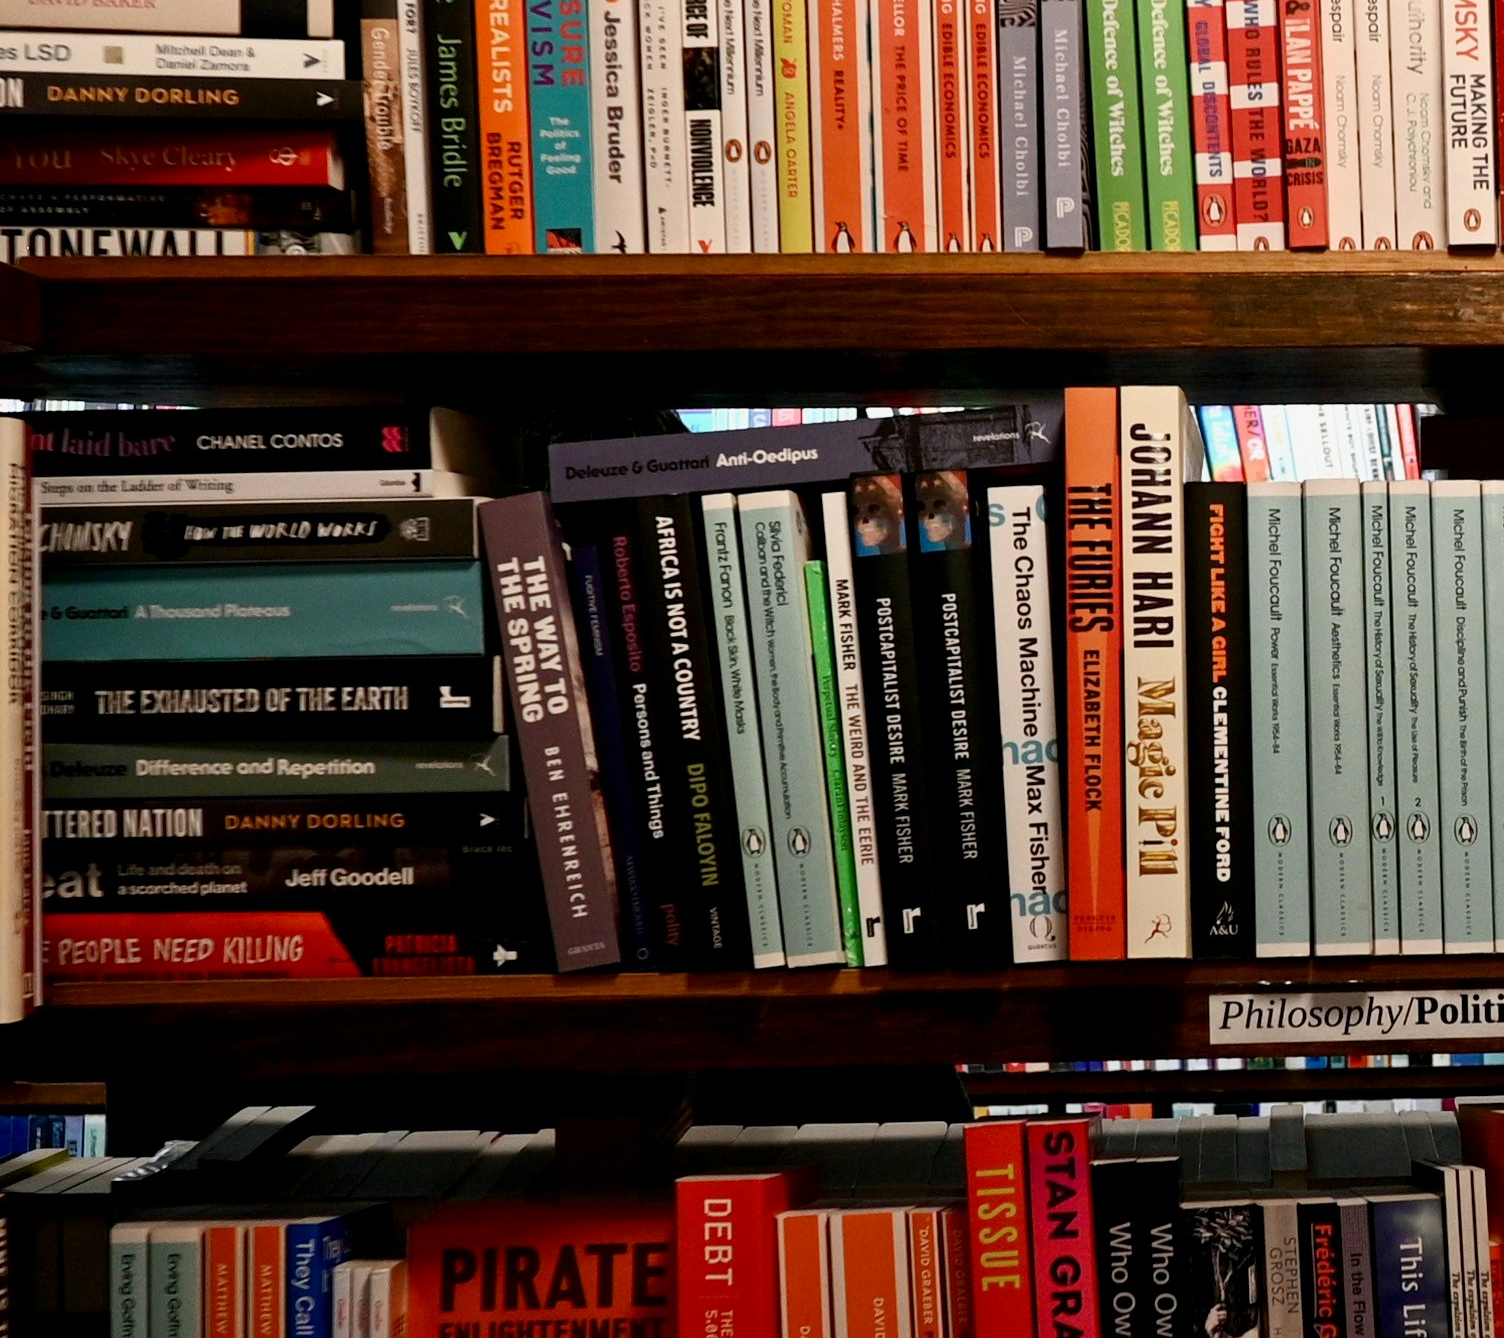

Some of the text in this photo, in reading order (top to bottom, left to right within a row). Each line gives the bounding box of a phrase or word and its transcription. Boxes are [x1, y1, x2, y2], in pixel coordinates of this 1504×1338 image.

[436, 34, 463, 110] James
[603, 11, 620, 95] Jessica
[441, 117, 467, 188] Bridle
[606, 106, 622, 184] Bruder
[196, 433, 343, 449] CHANEL CONTOS
[1131, 423, 1173, 649] JOHANN HARI
[225, 812, 405, 830] DANNY DORLING
[285, 868, 413, 889] Jeff Goodell
[1042, 1130, 1079, 1237] STAN
[438, 1242, 672, 1313] PIRATE
[703, 1197, 734, 1287] DEBT
